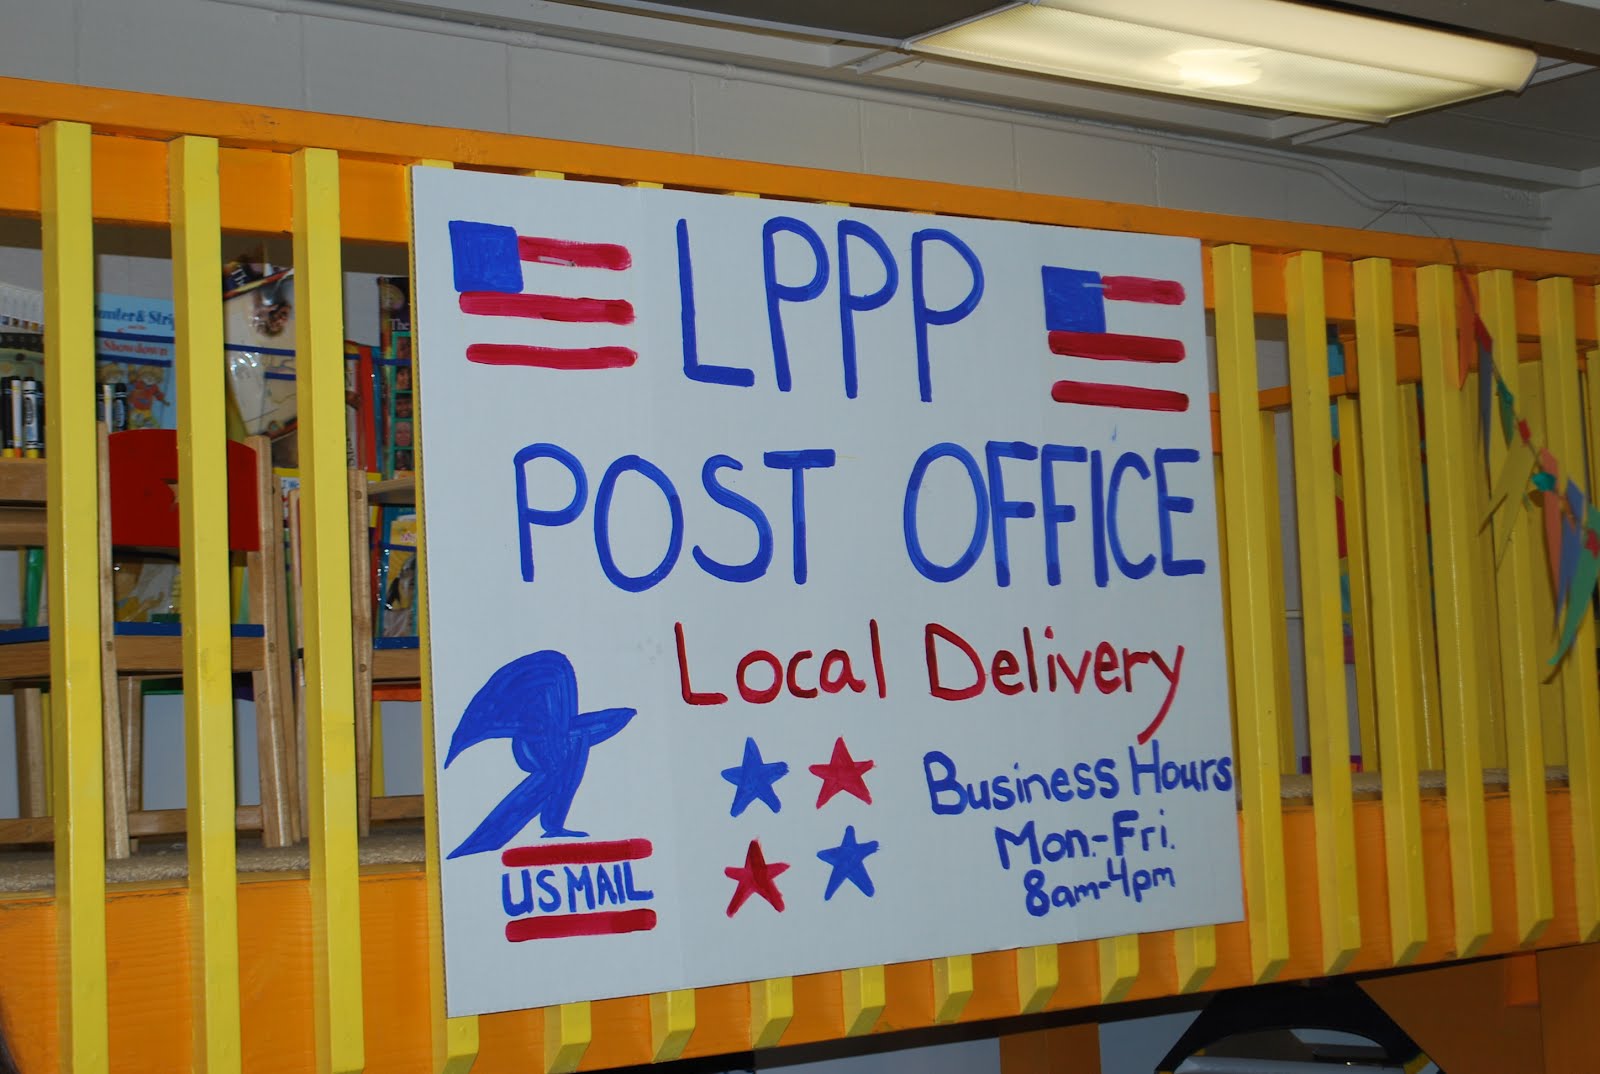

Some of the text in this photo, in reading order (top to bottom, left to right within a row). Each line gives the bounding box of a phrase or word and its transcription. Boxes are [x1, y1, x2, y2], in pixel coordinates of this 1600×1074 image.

[97, 307, 136, 322] unter
[677, 216, 984, 402] LPPP
[513, 440, 1206, 593] POST OFFICE
[674, 619, 1185, 745] Local Delivery
[923, 739, 1233, 815] Business Hours
